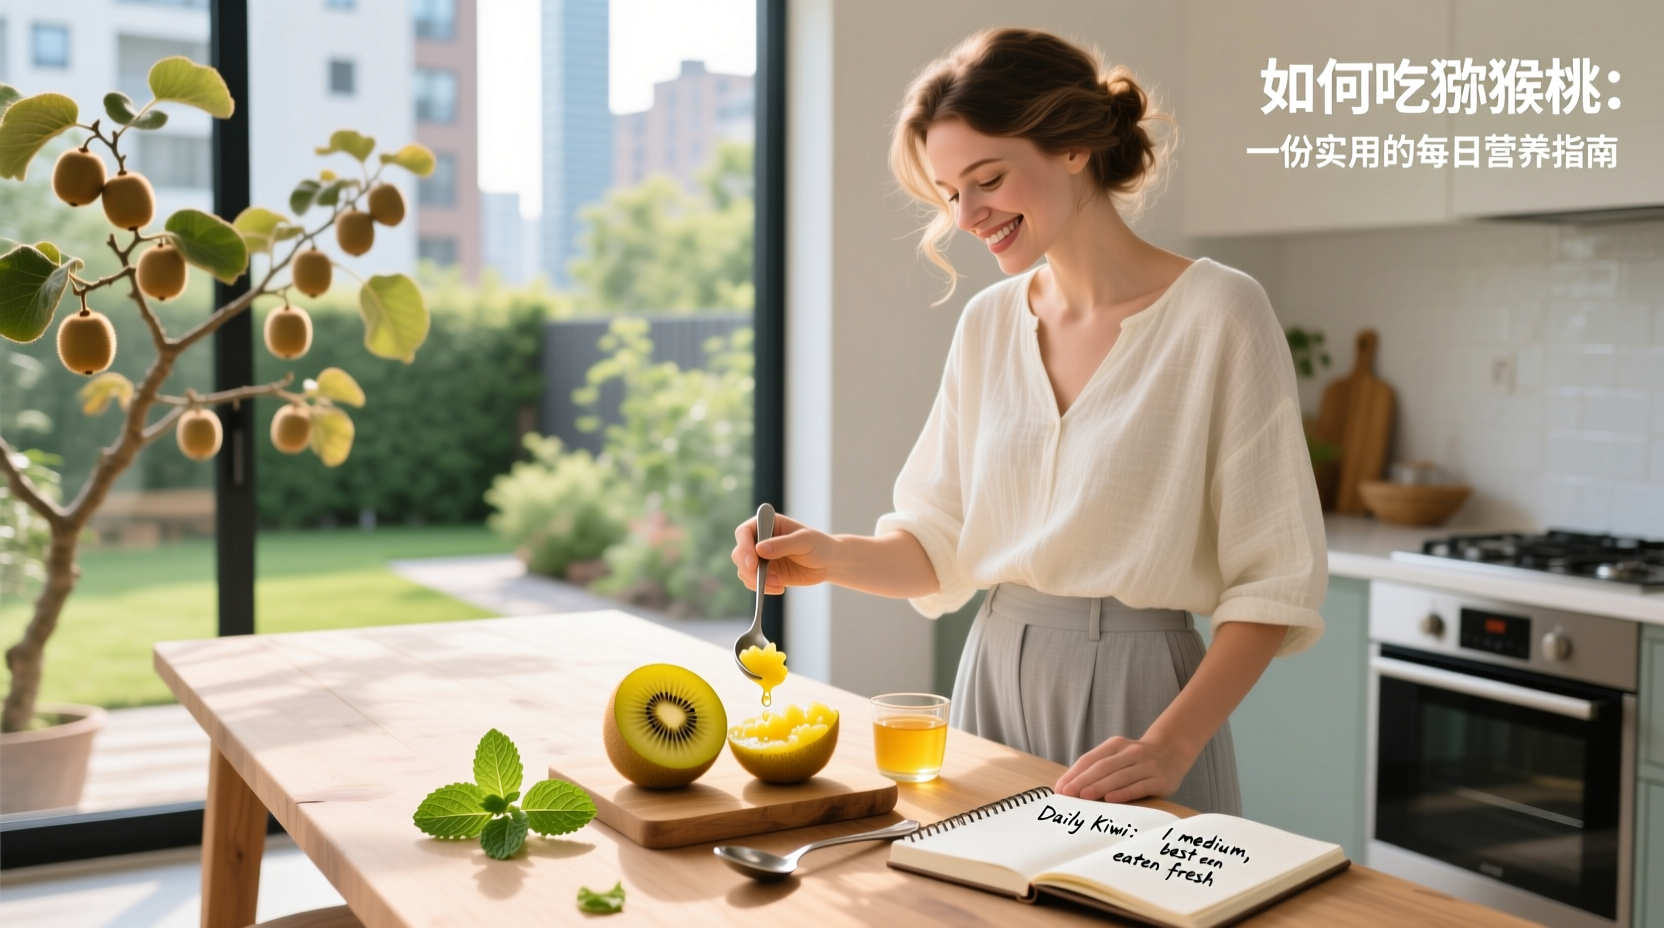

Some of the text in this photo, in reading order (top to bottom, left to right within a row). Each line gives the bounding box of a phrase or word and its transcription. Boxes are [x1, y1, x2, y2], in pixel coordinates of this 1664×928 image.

[1037, 804, 1085, 835] Daily
[1089, 814, 1138, 839] Kiwi:
[1177, 834, 1250, 864] medium,
[1112, 852, 1214, 887] eaten fresh
[1159, 842, 1198, 862] best
